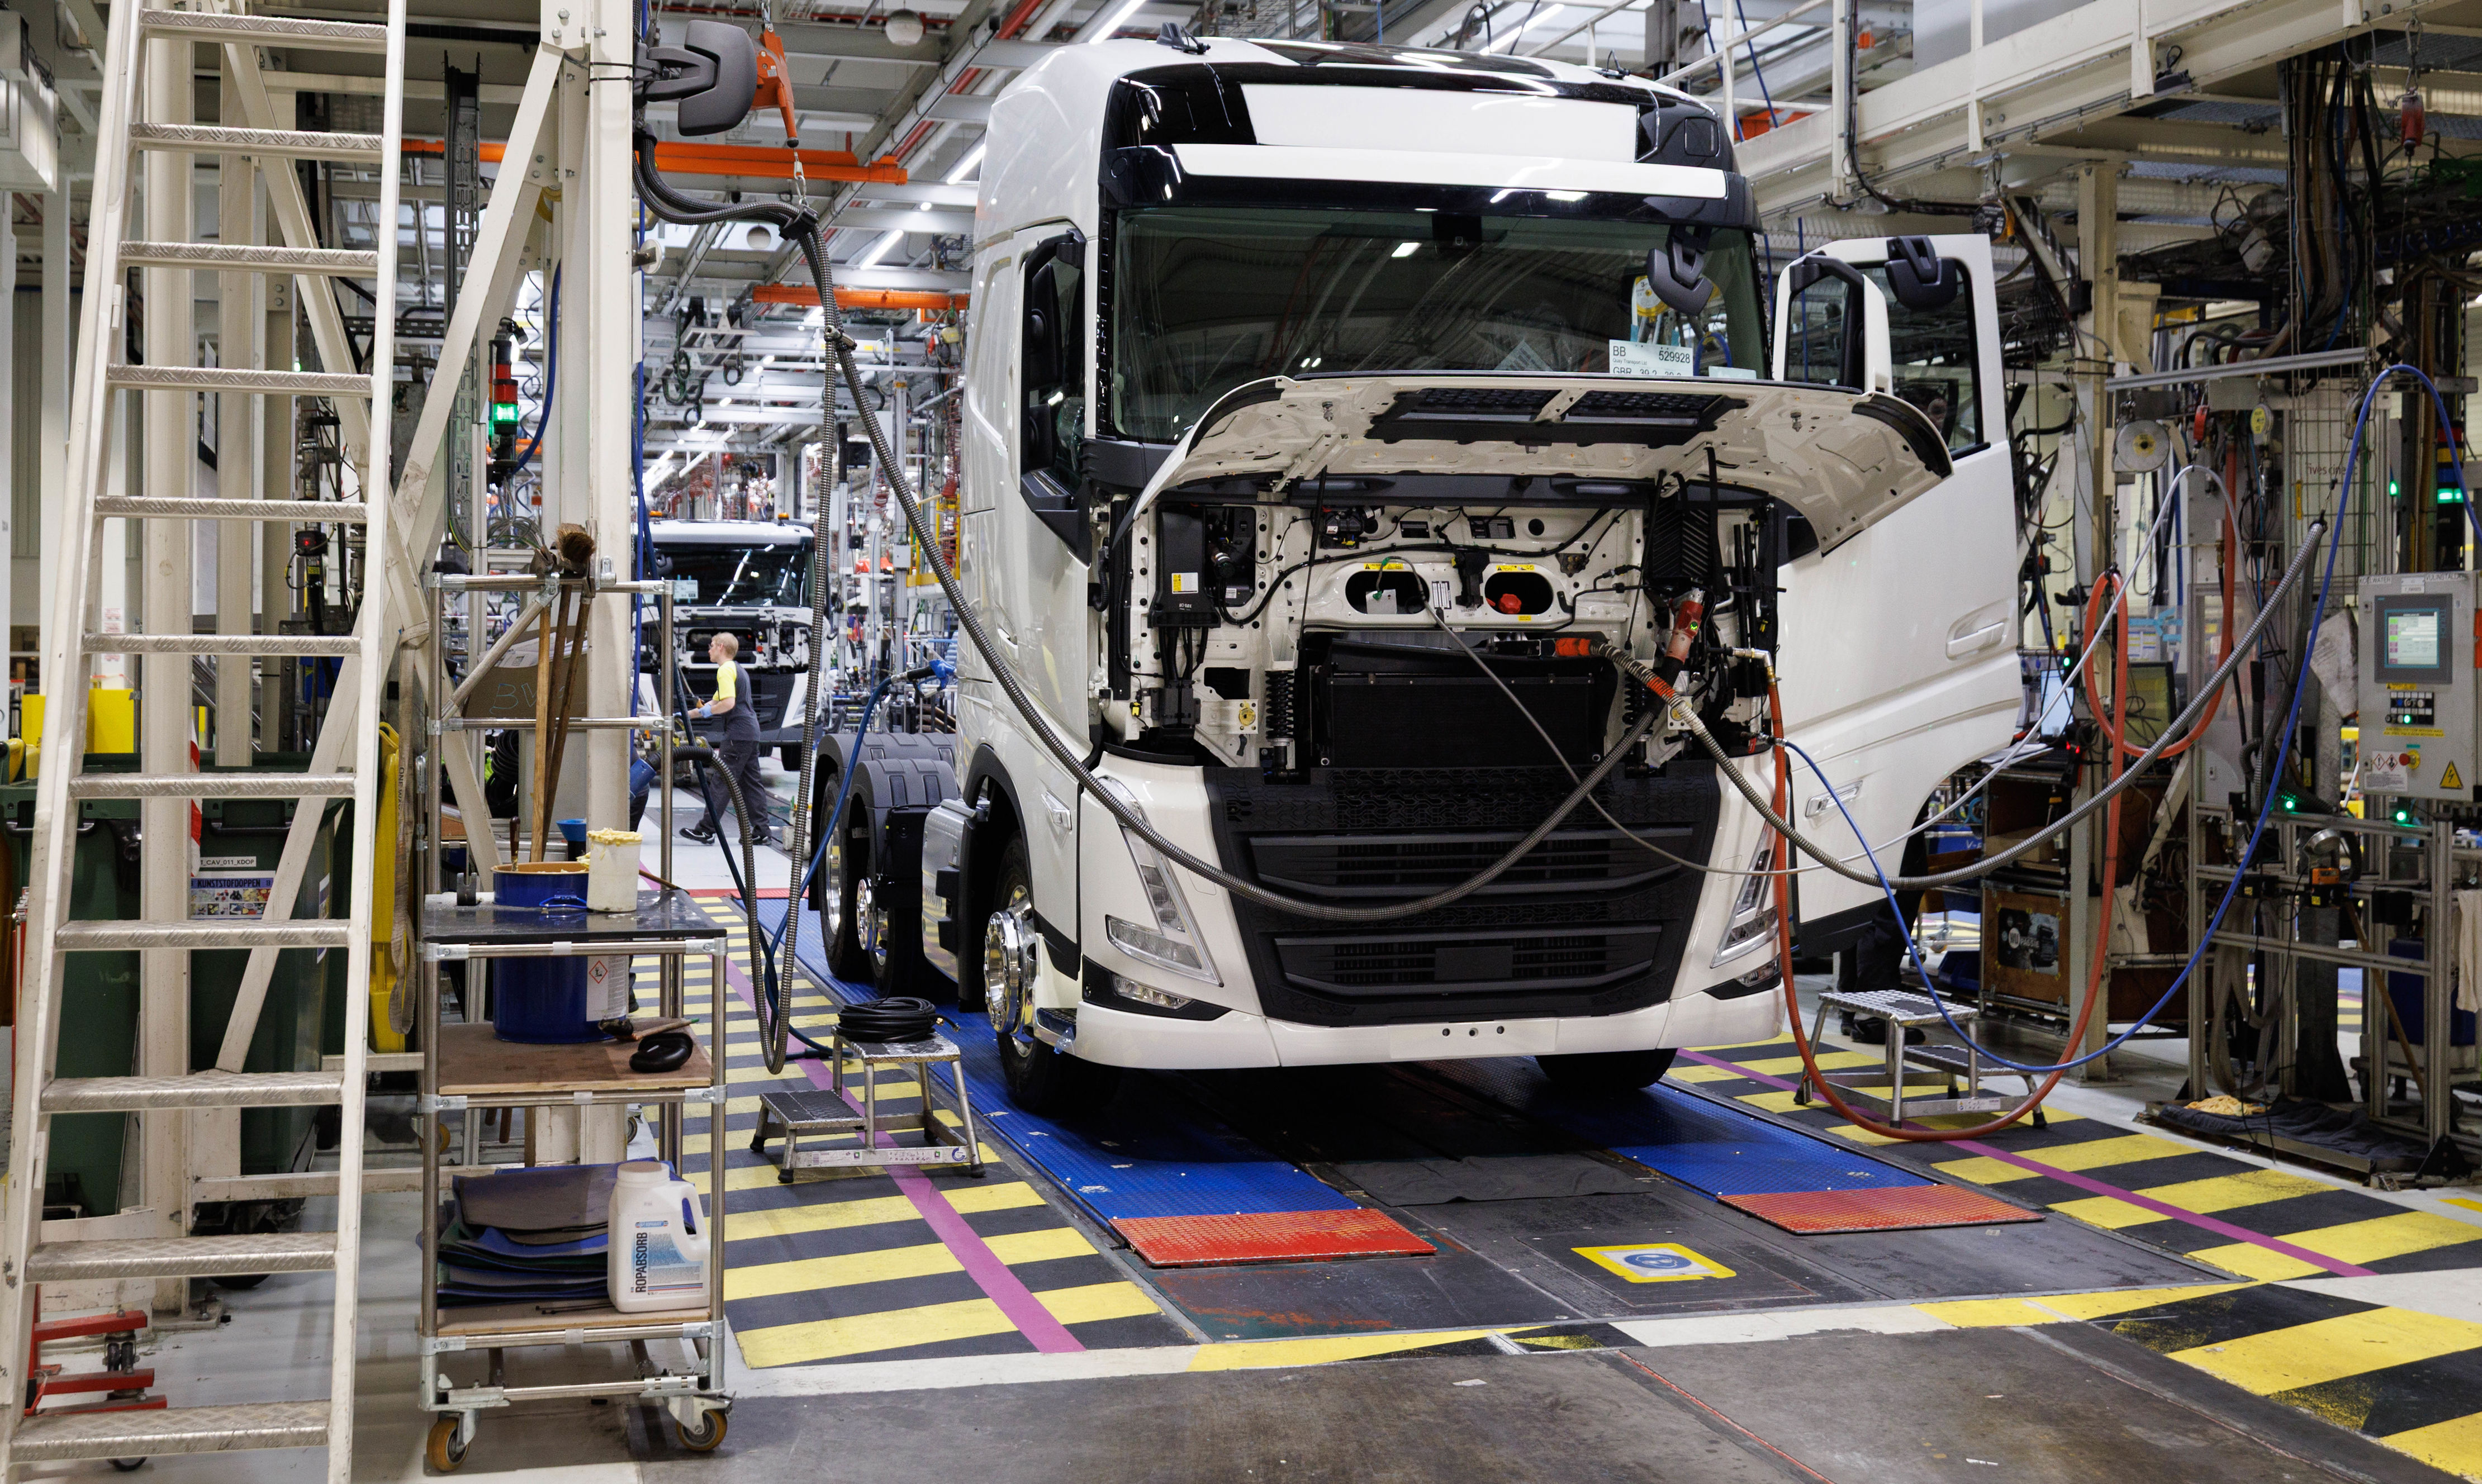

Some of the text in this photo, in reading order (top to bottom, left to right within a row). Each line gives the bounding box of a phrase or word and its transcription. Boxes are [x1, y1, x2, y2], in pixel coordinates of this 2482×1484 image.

[1613, 346, 1690, 364] BB 529928
[198, 879, 260, 887] KUNSTSTOFDOPPEN
[635, 1232, 647, 1292] ROPABSORB
